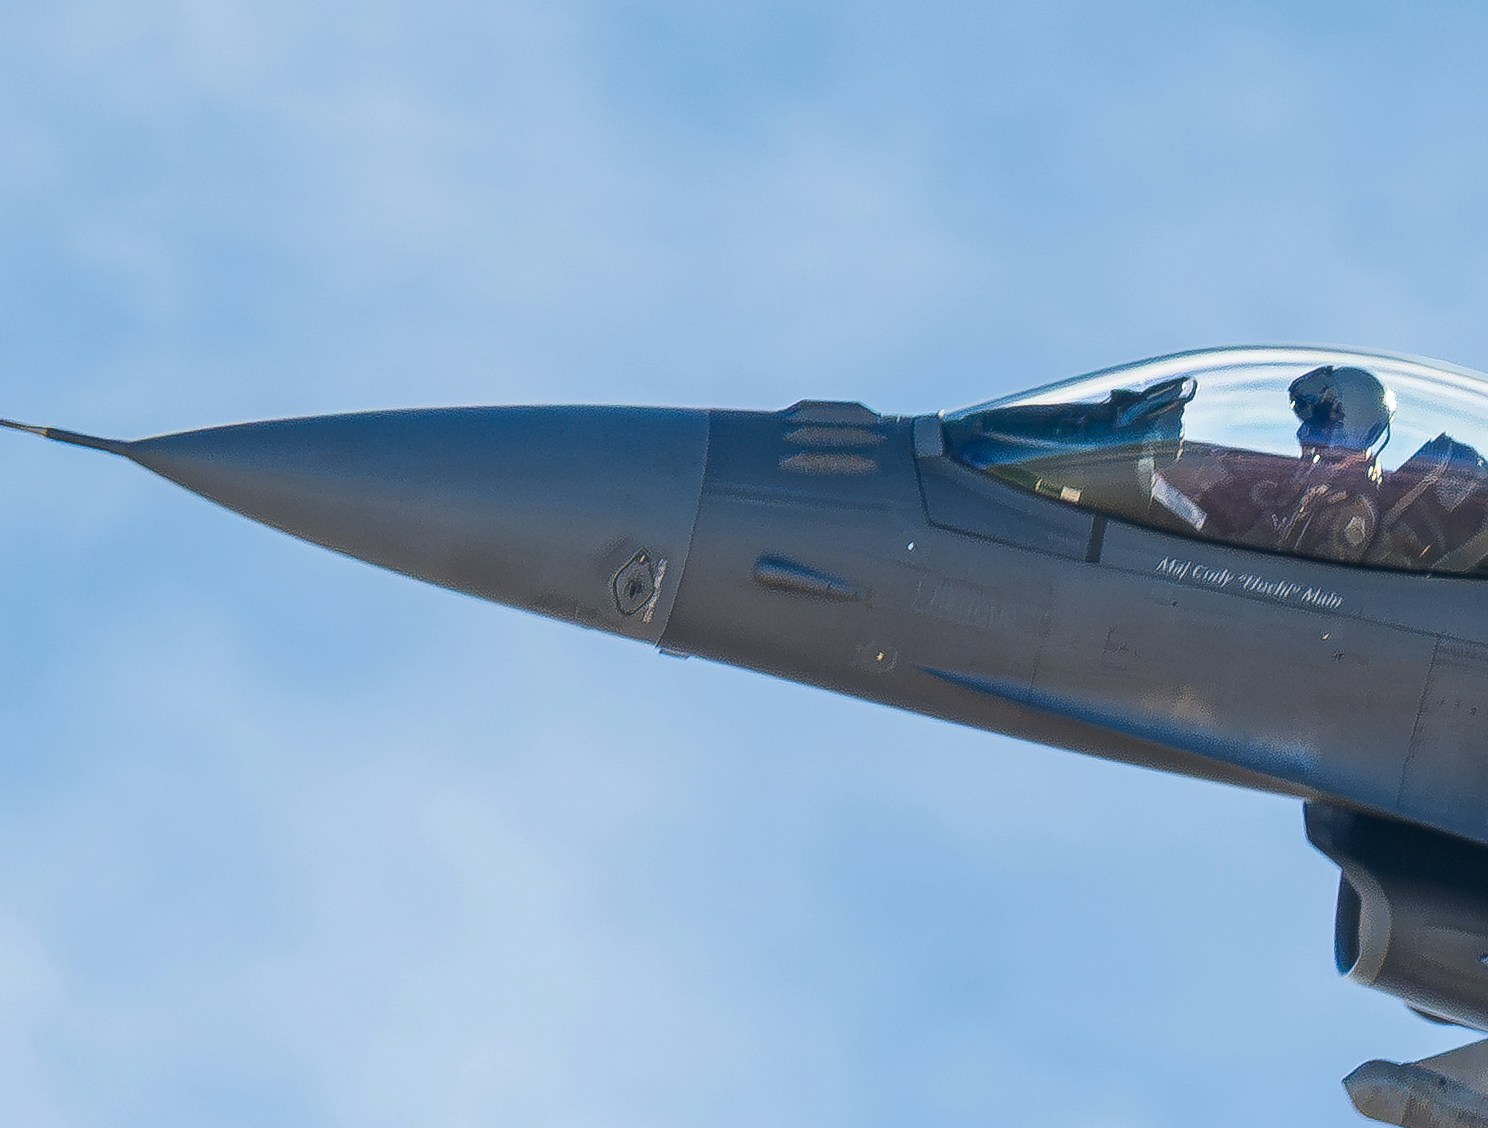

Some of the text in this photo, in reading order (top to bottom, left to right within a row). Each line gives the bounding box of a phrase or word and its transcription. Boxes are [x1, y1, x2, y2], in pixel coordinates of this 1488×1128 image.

[1156, 556, 1191, 580] Maj
[1192, 564, 1234, 588] Cody
[1301, 586, 1343, 609] Main
